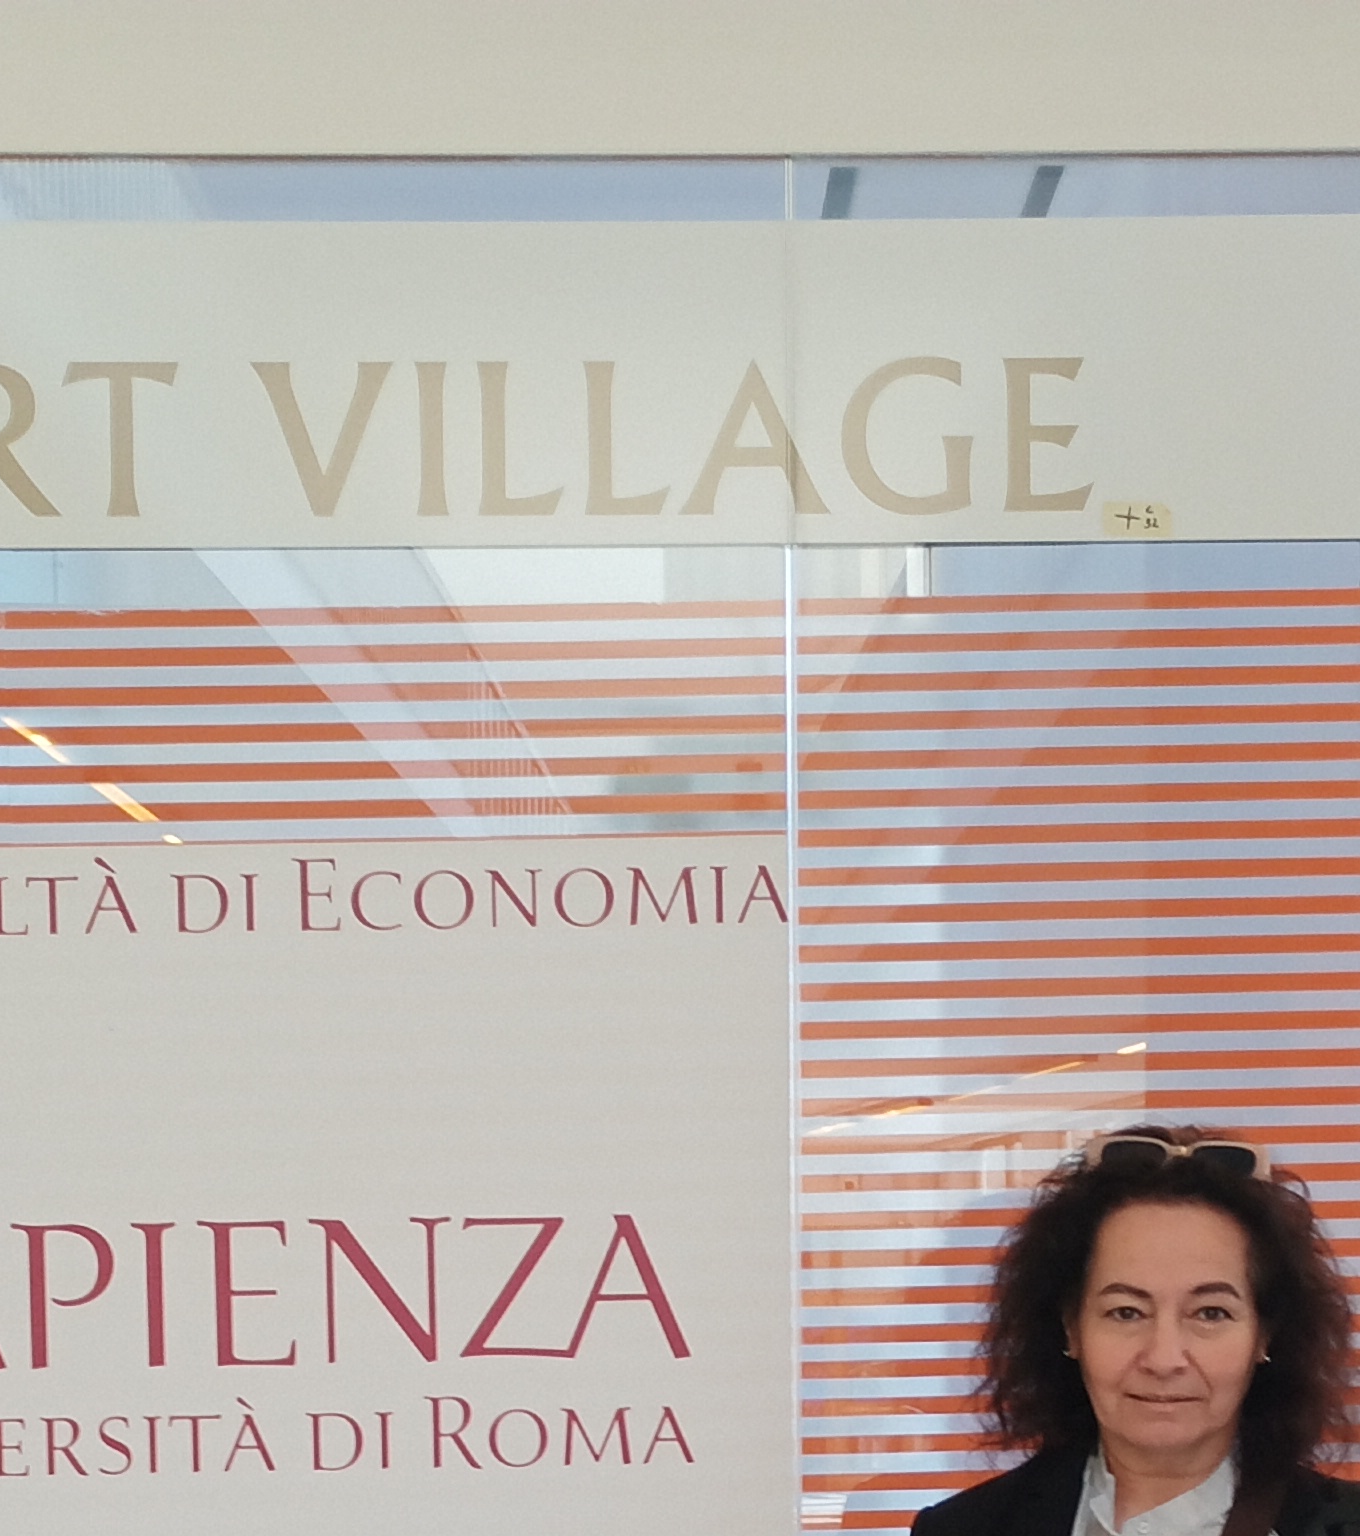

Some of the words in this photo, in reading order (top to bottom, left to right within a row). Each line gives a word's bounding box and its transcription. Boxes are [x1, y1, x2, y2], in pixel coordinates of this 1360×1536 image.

[251, 356, 1094, 516] VILLAGE
[173, 873, 259, 934] DI
[295, 857, 787, 932] ECONOMIA
[306, 1411, 394, 1472] DI
[422, 1395, 696, 1471] ROMA
